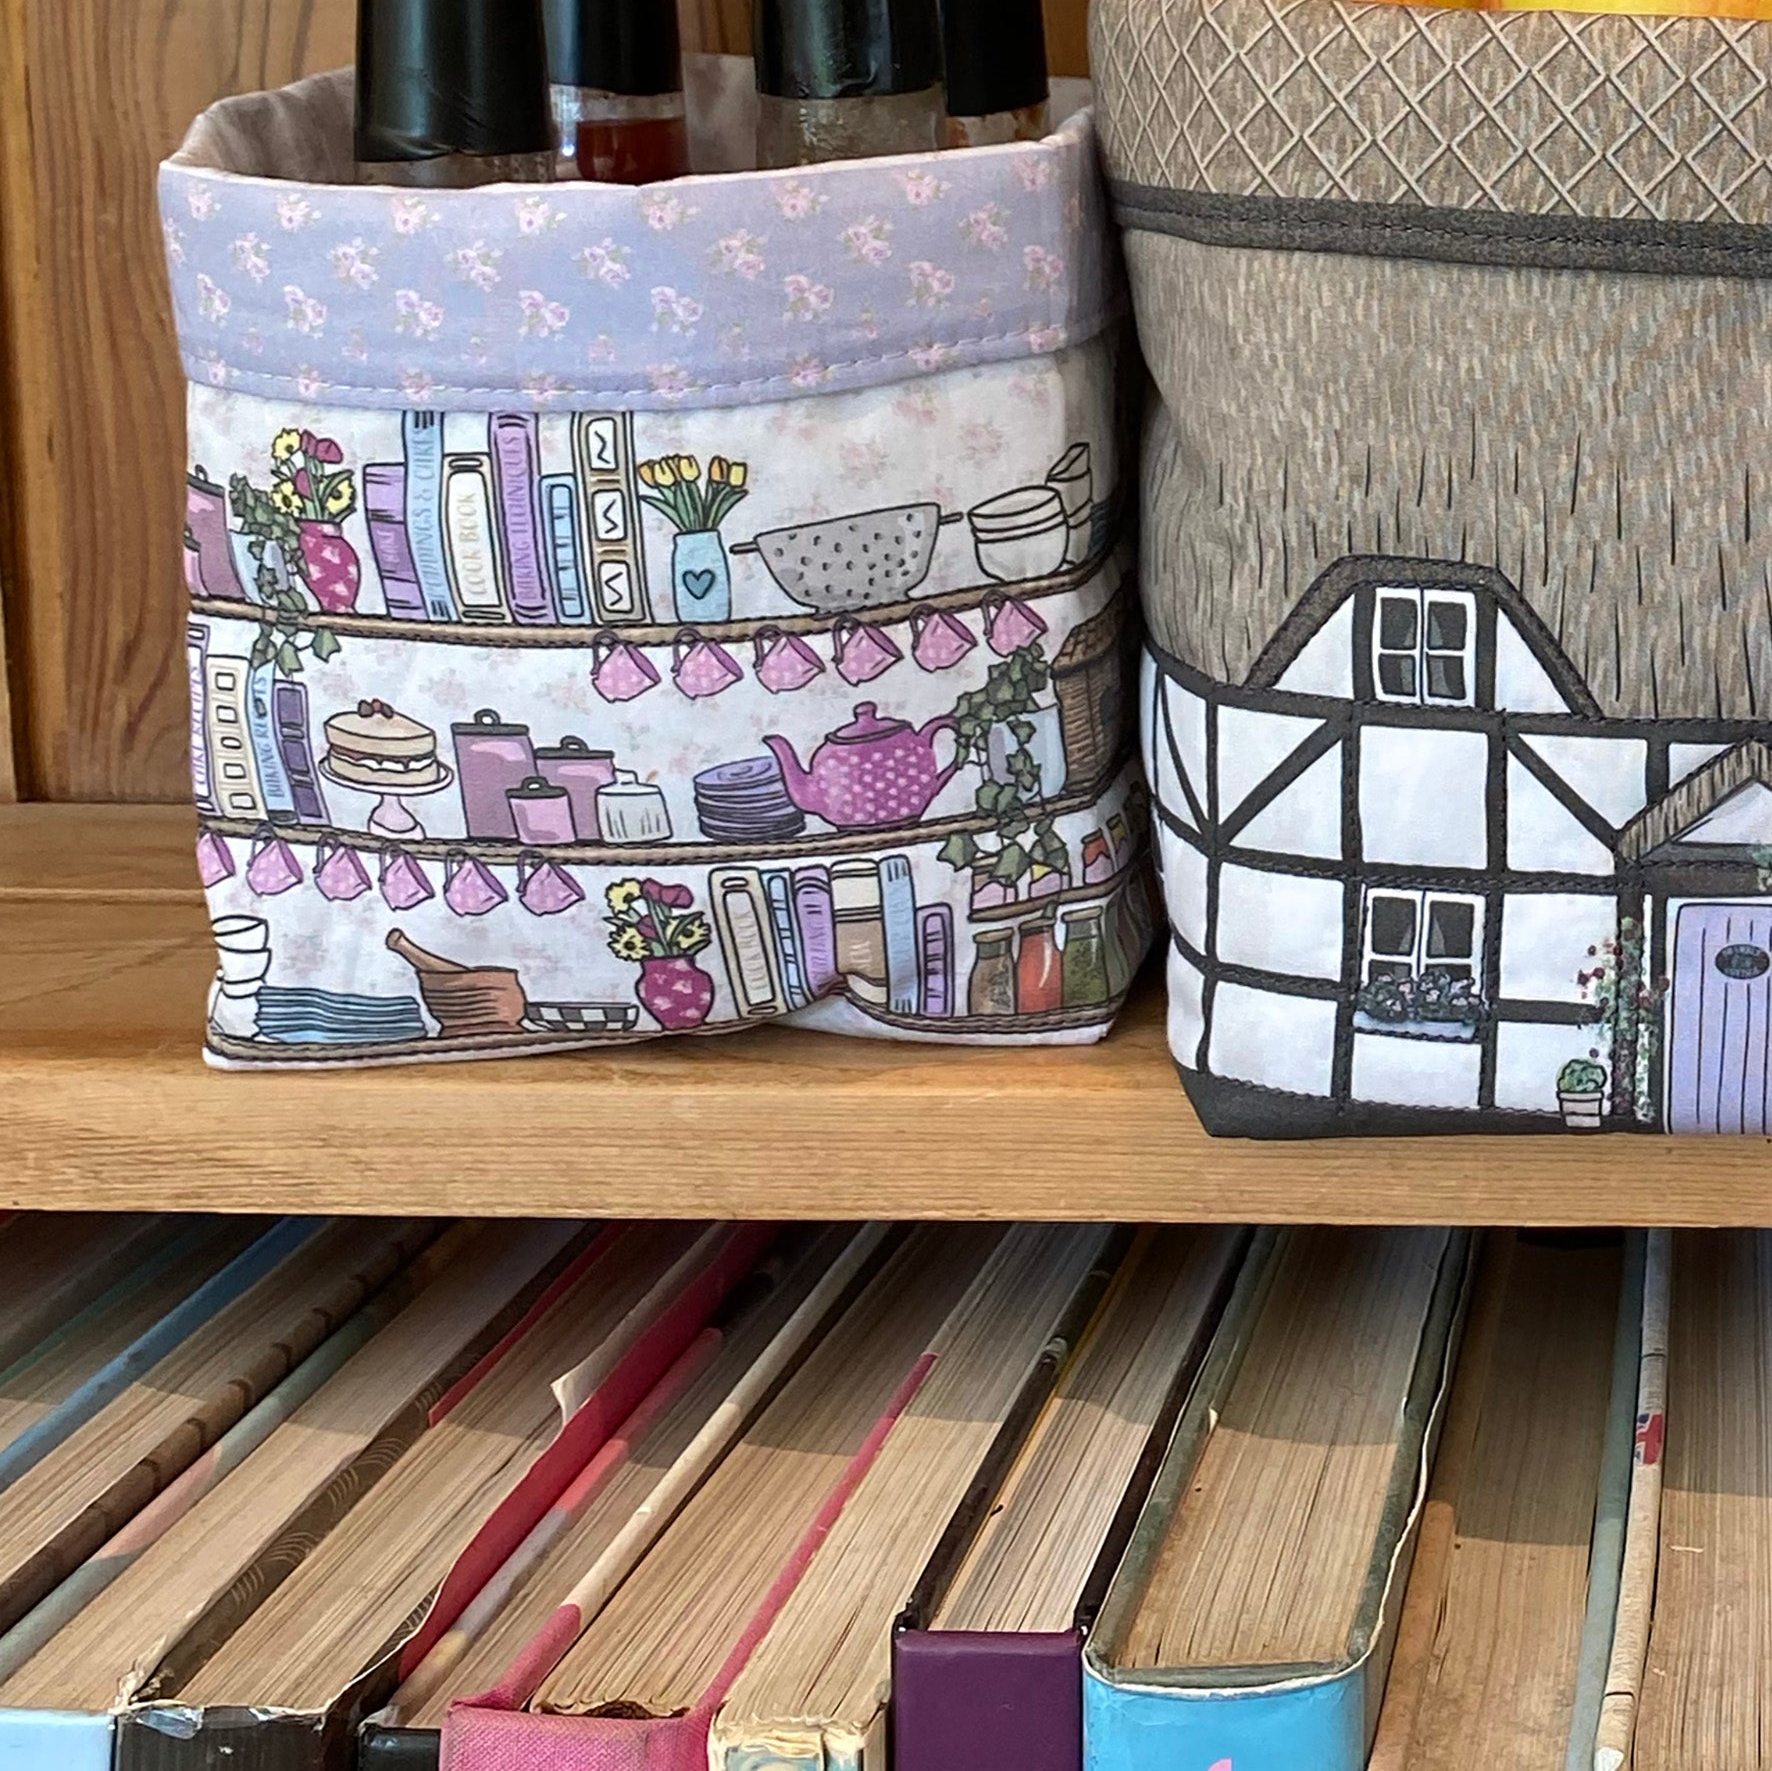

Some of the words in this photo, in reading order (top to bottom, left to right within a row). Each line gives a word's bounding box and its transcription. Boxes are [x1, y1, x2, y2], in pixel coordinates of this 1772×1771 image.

[456, 491, 480, 544] BOOK
[459, 549, 488, 596] COOK
[258, 742, 286, 798] BAKING
